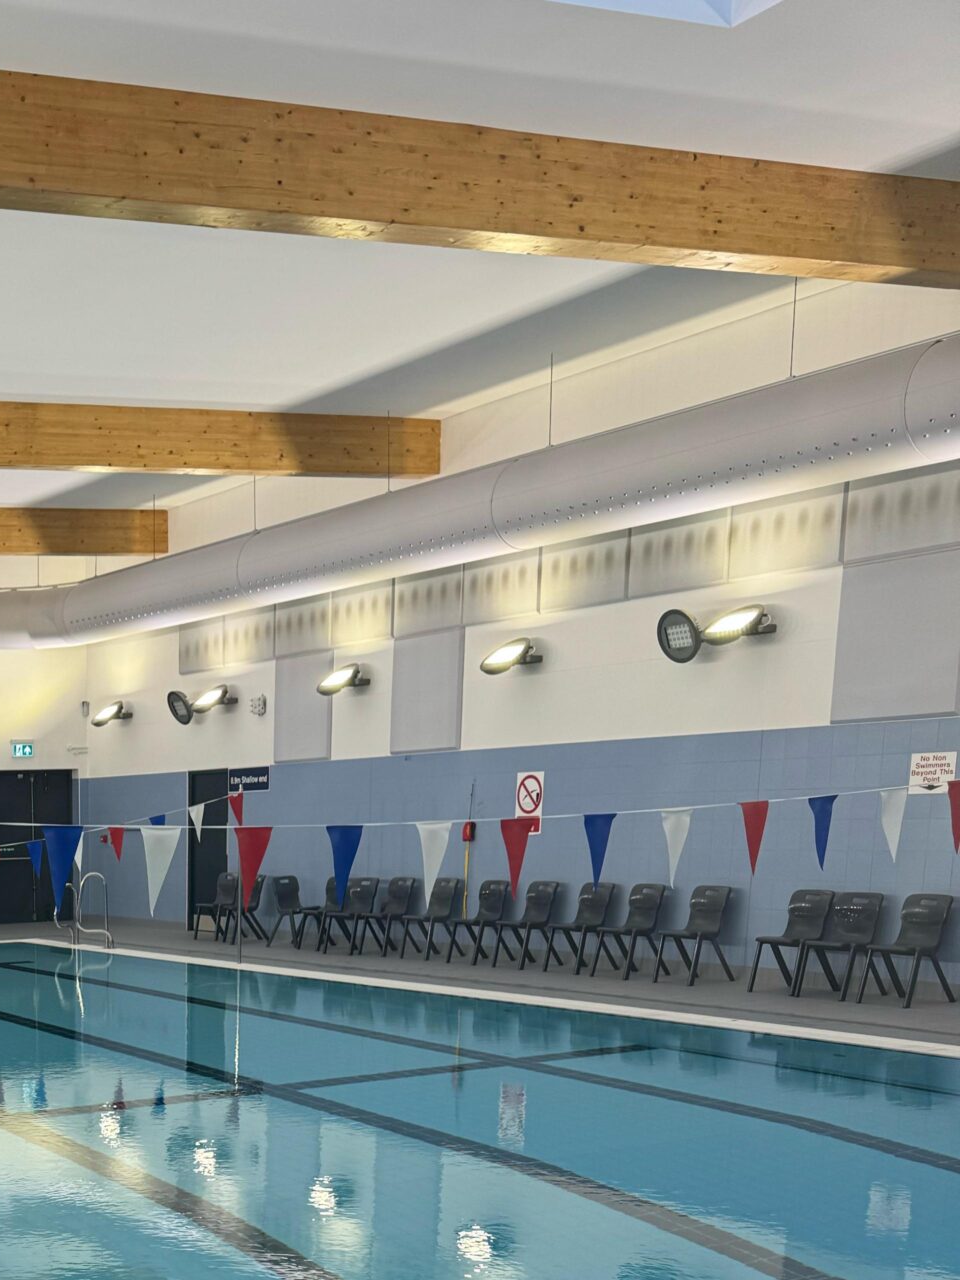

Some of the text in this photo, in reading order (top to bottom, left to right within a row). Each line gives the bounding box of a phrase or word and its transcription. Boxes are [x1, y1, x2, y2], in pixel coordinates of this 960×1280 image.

[915, 762, 951, 770] Swimmers
[911, 769, 937, 777] Beyond
[241, 775, 258, 784] Shallow
[258, 773, 268, 783] end
